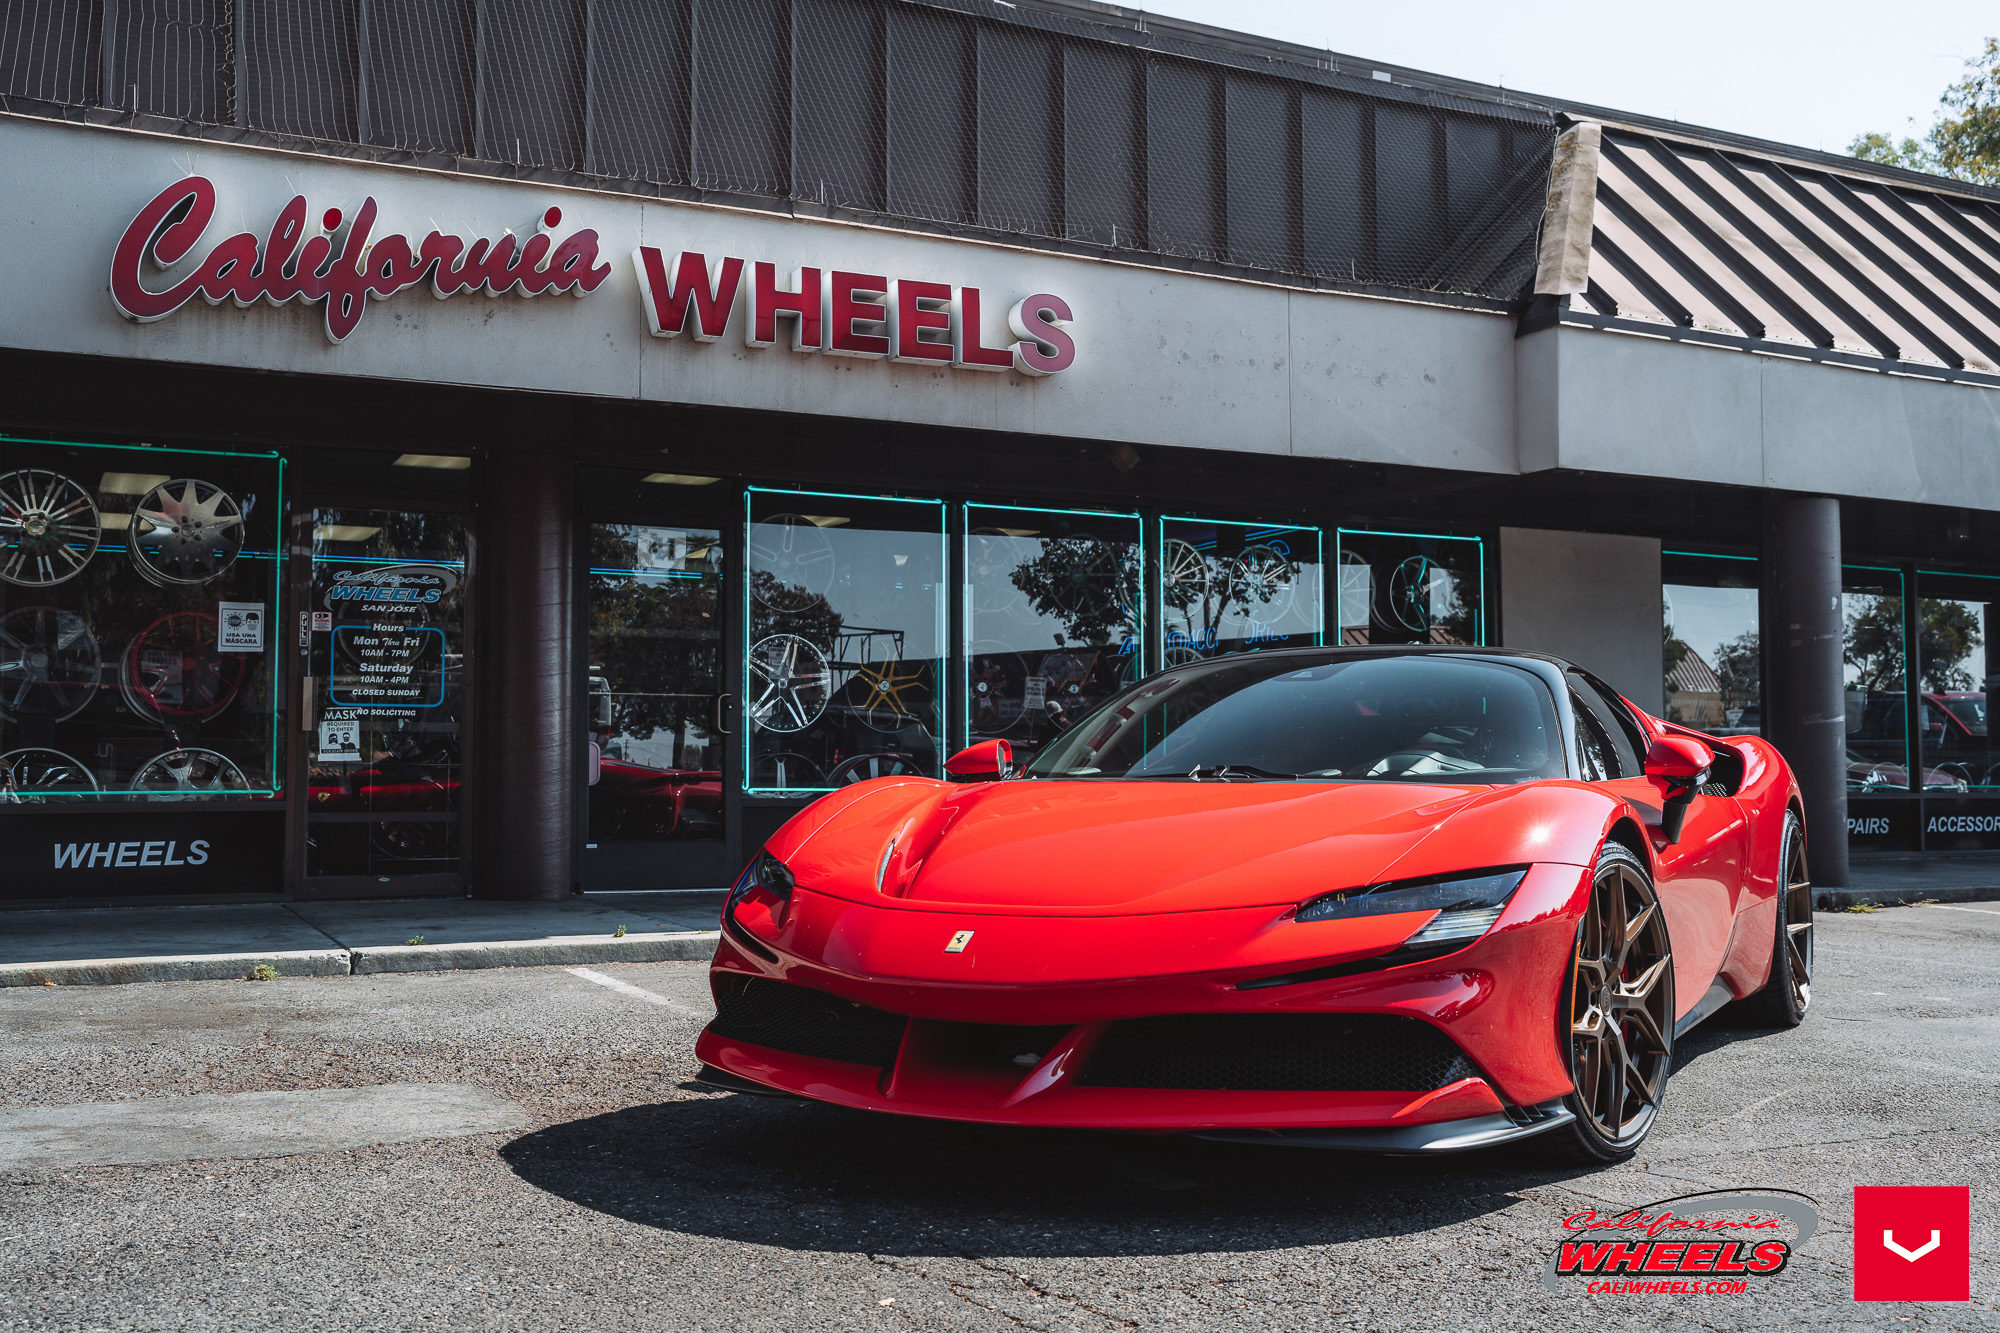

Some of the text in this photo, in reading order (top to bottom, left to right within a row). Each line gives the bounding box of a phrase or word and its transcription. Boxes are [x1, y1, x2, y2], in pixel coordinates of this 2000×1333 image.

[109, 174, 1077, 378] California WHEELS
[333, 570, 440, 585] California
[331, 585, 442, 603] WHEELS
[361, 604, 417, 613] SAN JOSE
[372, 623, 405, 632] Hours
[353, 636, 420, 646] Mon Thru Fri
[360, 649, 385, 657] 10AM
[359, 662, 414, 674] Saturday
[324, 710, 358, 720] MASK
[53, 839, 211, 869] WHEELS
